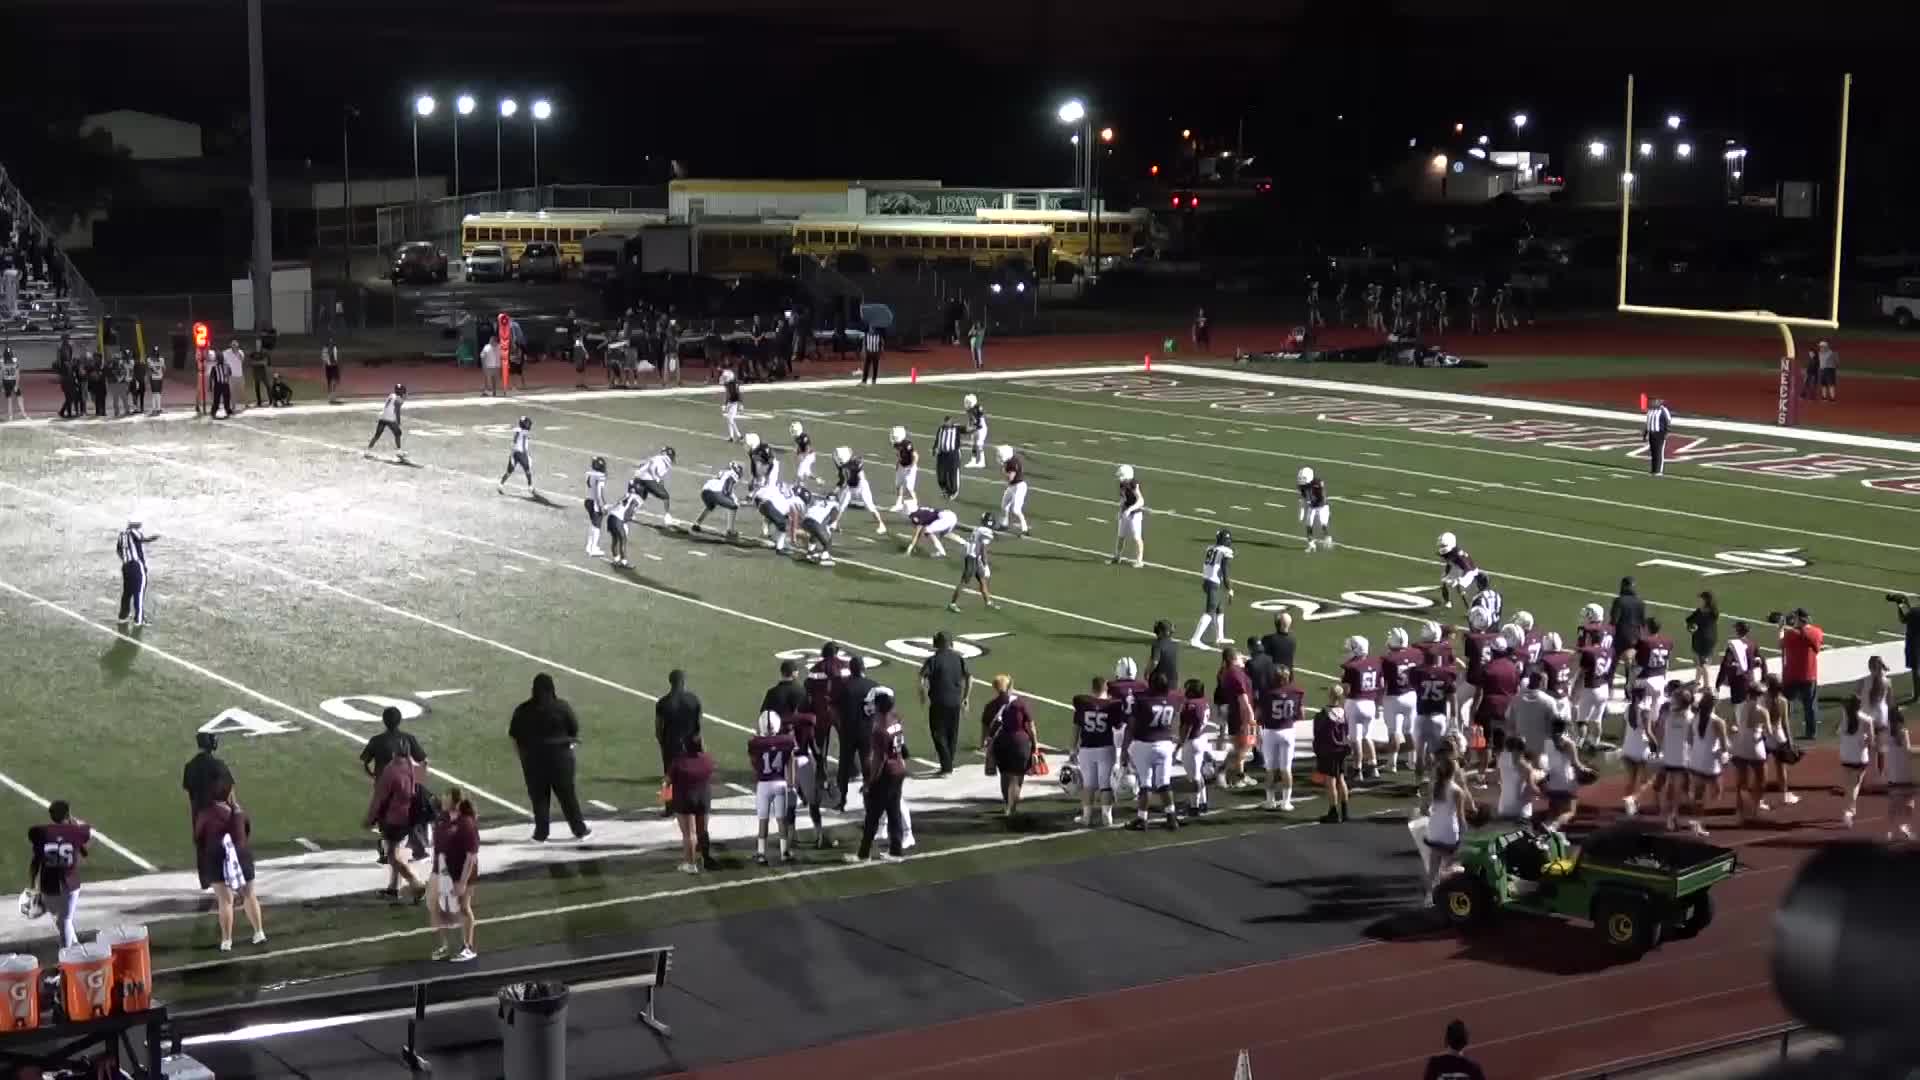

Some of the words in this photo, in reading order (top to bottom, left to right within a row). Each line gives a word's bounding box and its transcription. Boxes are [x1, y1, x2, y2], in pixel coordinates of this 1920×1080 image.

[936, 195, 988, 213] IOWA
[196, 325, 207, 346] 2
[1778, 359, 1790, 424] NECKS
[1635, 551, 1806, 576] 10
[1250, 591, 1434, 620] 20
[1421, 680, 1443, 702] 75
[198, 695, 424, 737] 40
[1272, 700, 1294, 721] 50
[1084, 711, 1108, 733] 55
[762, 752, 784, 774] 14
[87, 970, 104, 988] G
[11, 983, 27, 1000] G
